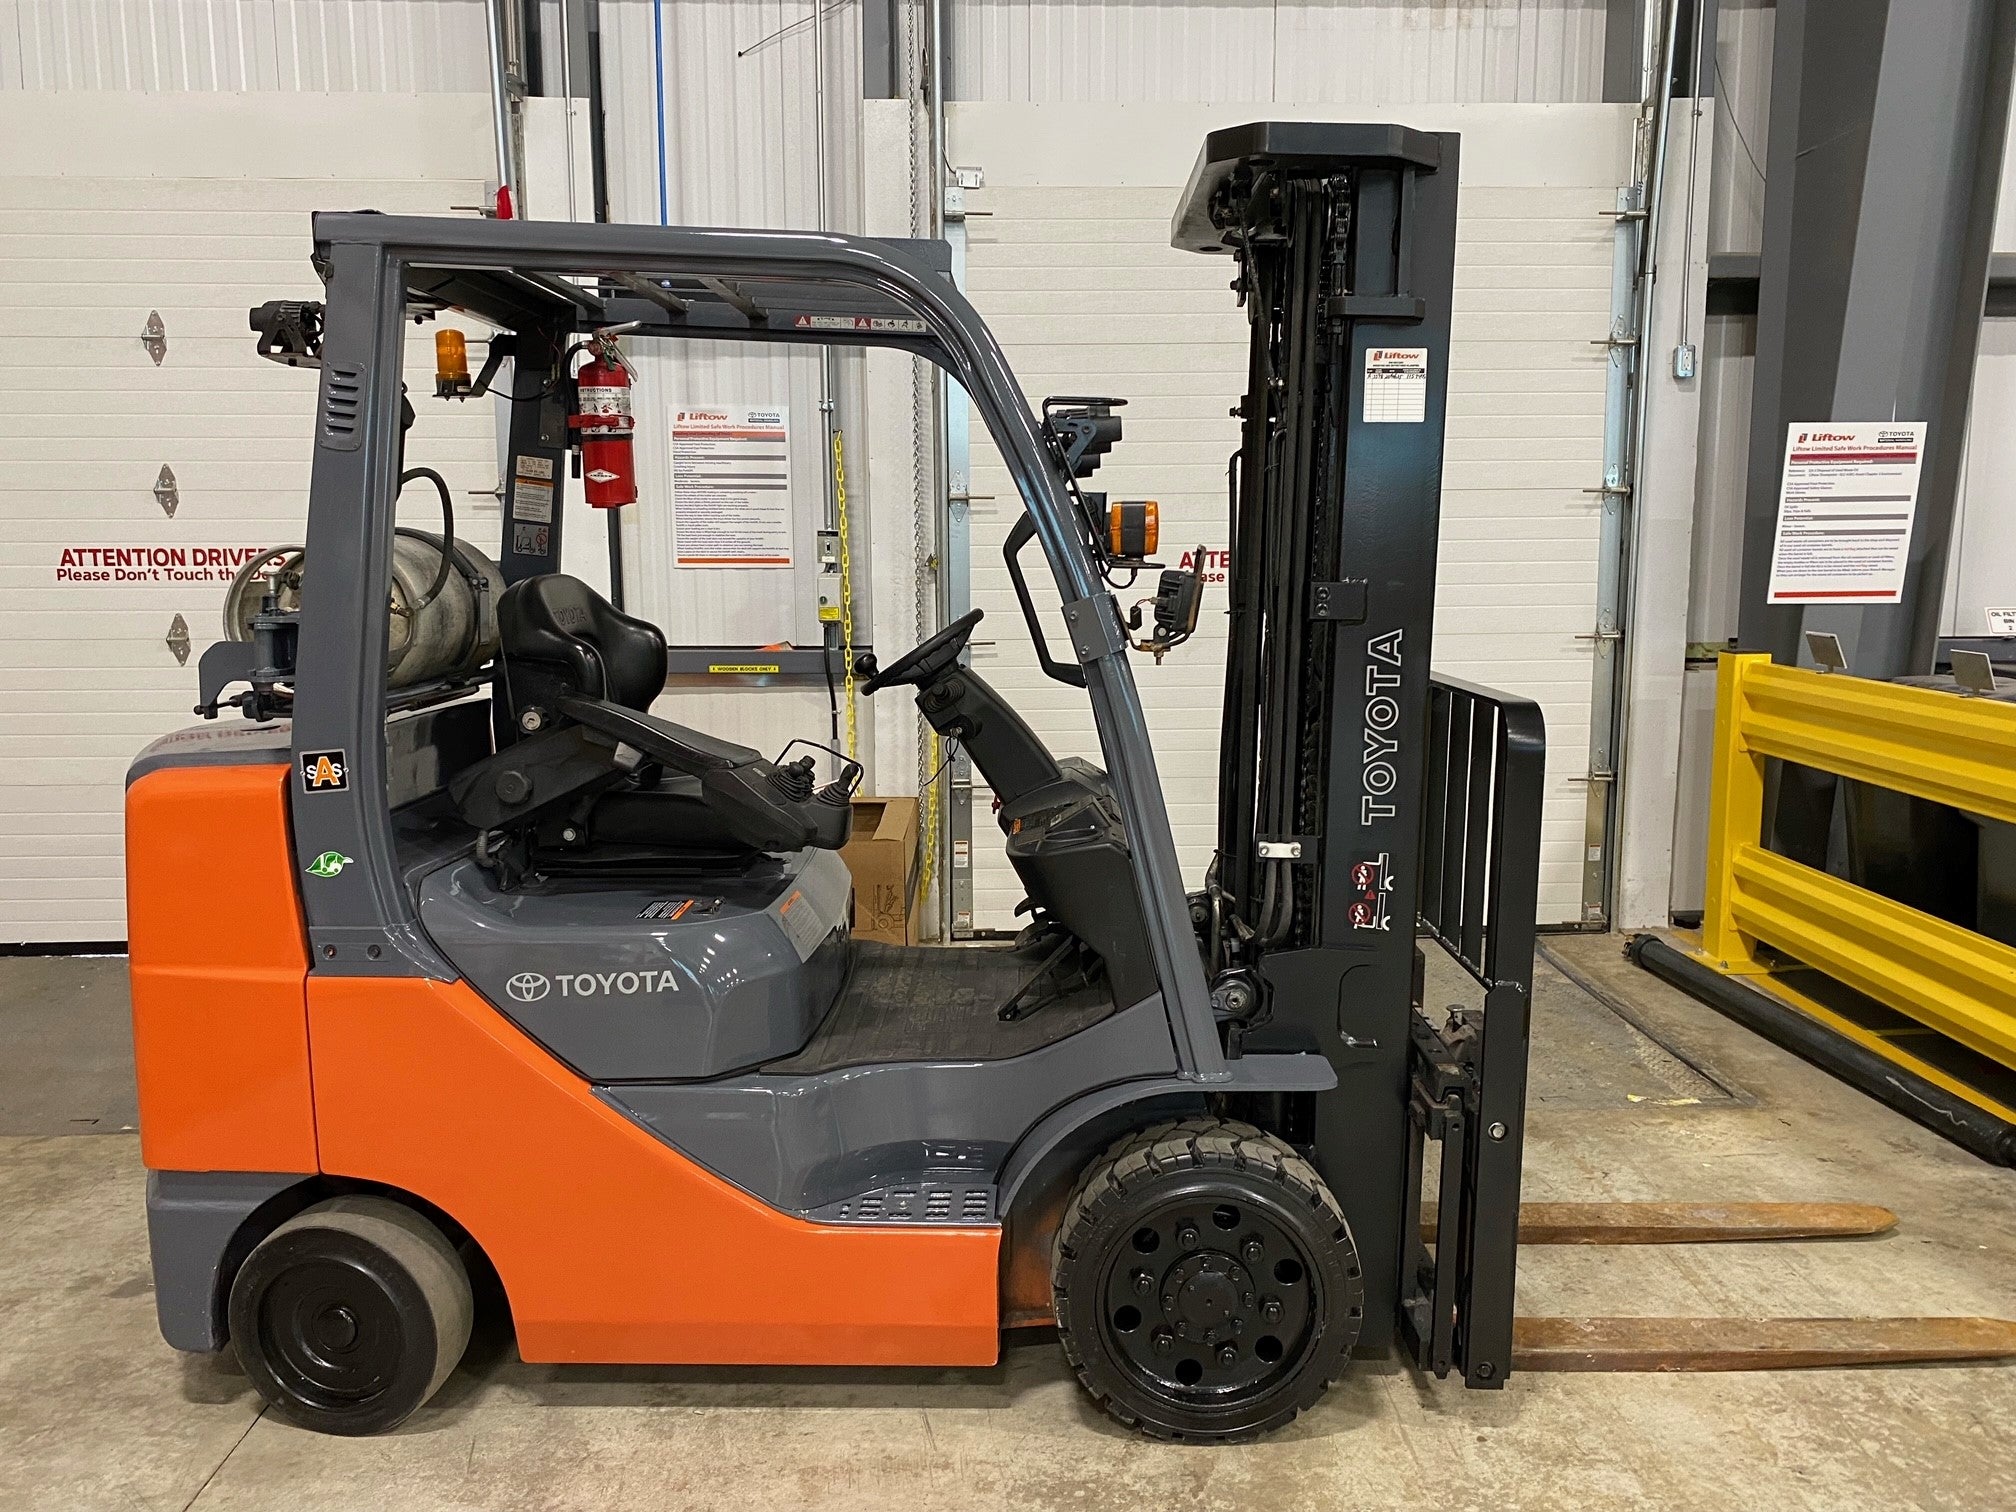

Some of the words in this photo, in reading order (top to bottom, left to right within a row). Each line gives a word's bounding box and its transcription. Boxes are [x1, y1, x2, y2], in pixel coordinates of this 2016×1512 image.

[689, 412, 728, 421] Liftow
[1812, 433, 1856, 441] Liftow
[60, 548, 186, 567] ATTENTION
[56, 568, 110, 581] Please
[115, 568, 160, 581] Don't
[163, 568, 214, 581] Touch
[1361, 628, 1403, 826] TOYOTA
[555, 970, 680, 997] TOYOTA
